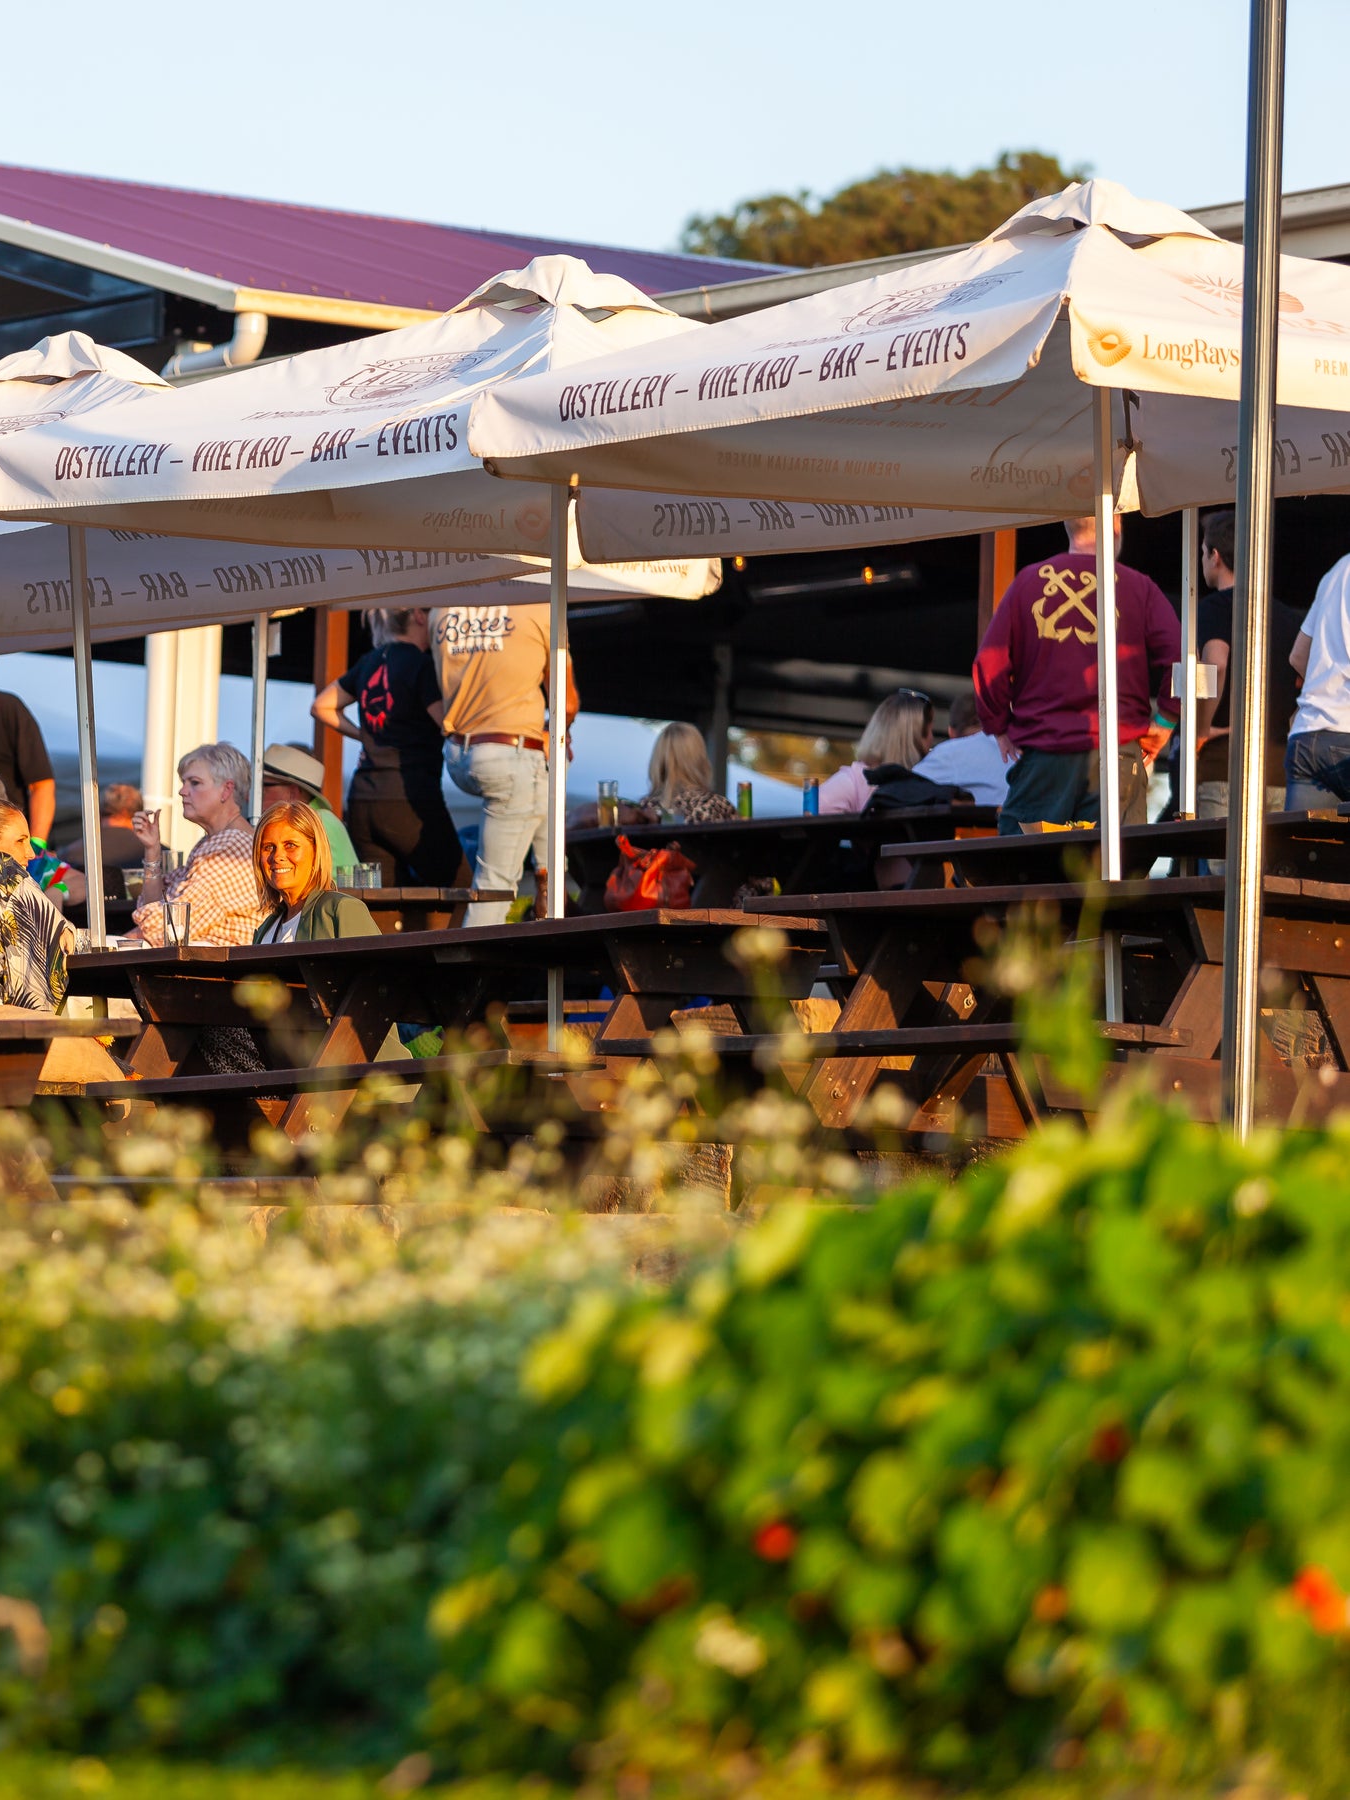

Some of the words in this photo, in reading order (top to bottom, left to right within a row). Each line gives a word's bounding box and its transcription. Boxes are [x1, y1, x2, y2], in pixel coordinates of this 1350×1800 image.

[559, 372, 679, 422] DISTILLERY
[698, 354, 799, 401] VINEYARD
[818, 342, 865, 382] BAR
[886, 322, 970, 371] EVENTS
[1141, 334, 1240, 373] LongRays
[1314, 358, 1349, 377] PREM
[55, 442, 173, 481] DISTILLERY
[192, 435, 291, 472] VINEYARD
[310, 428, 355, 463] BAR
[376, 413, 458, 457] EVENTS
[436, 613, 515, 644] Boxer
